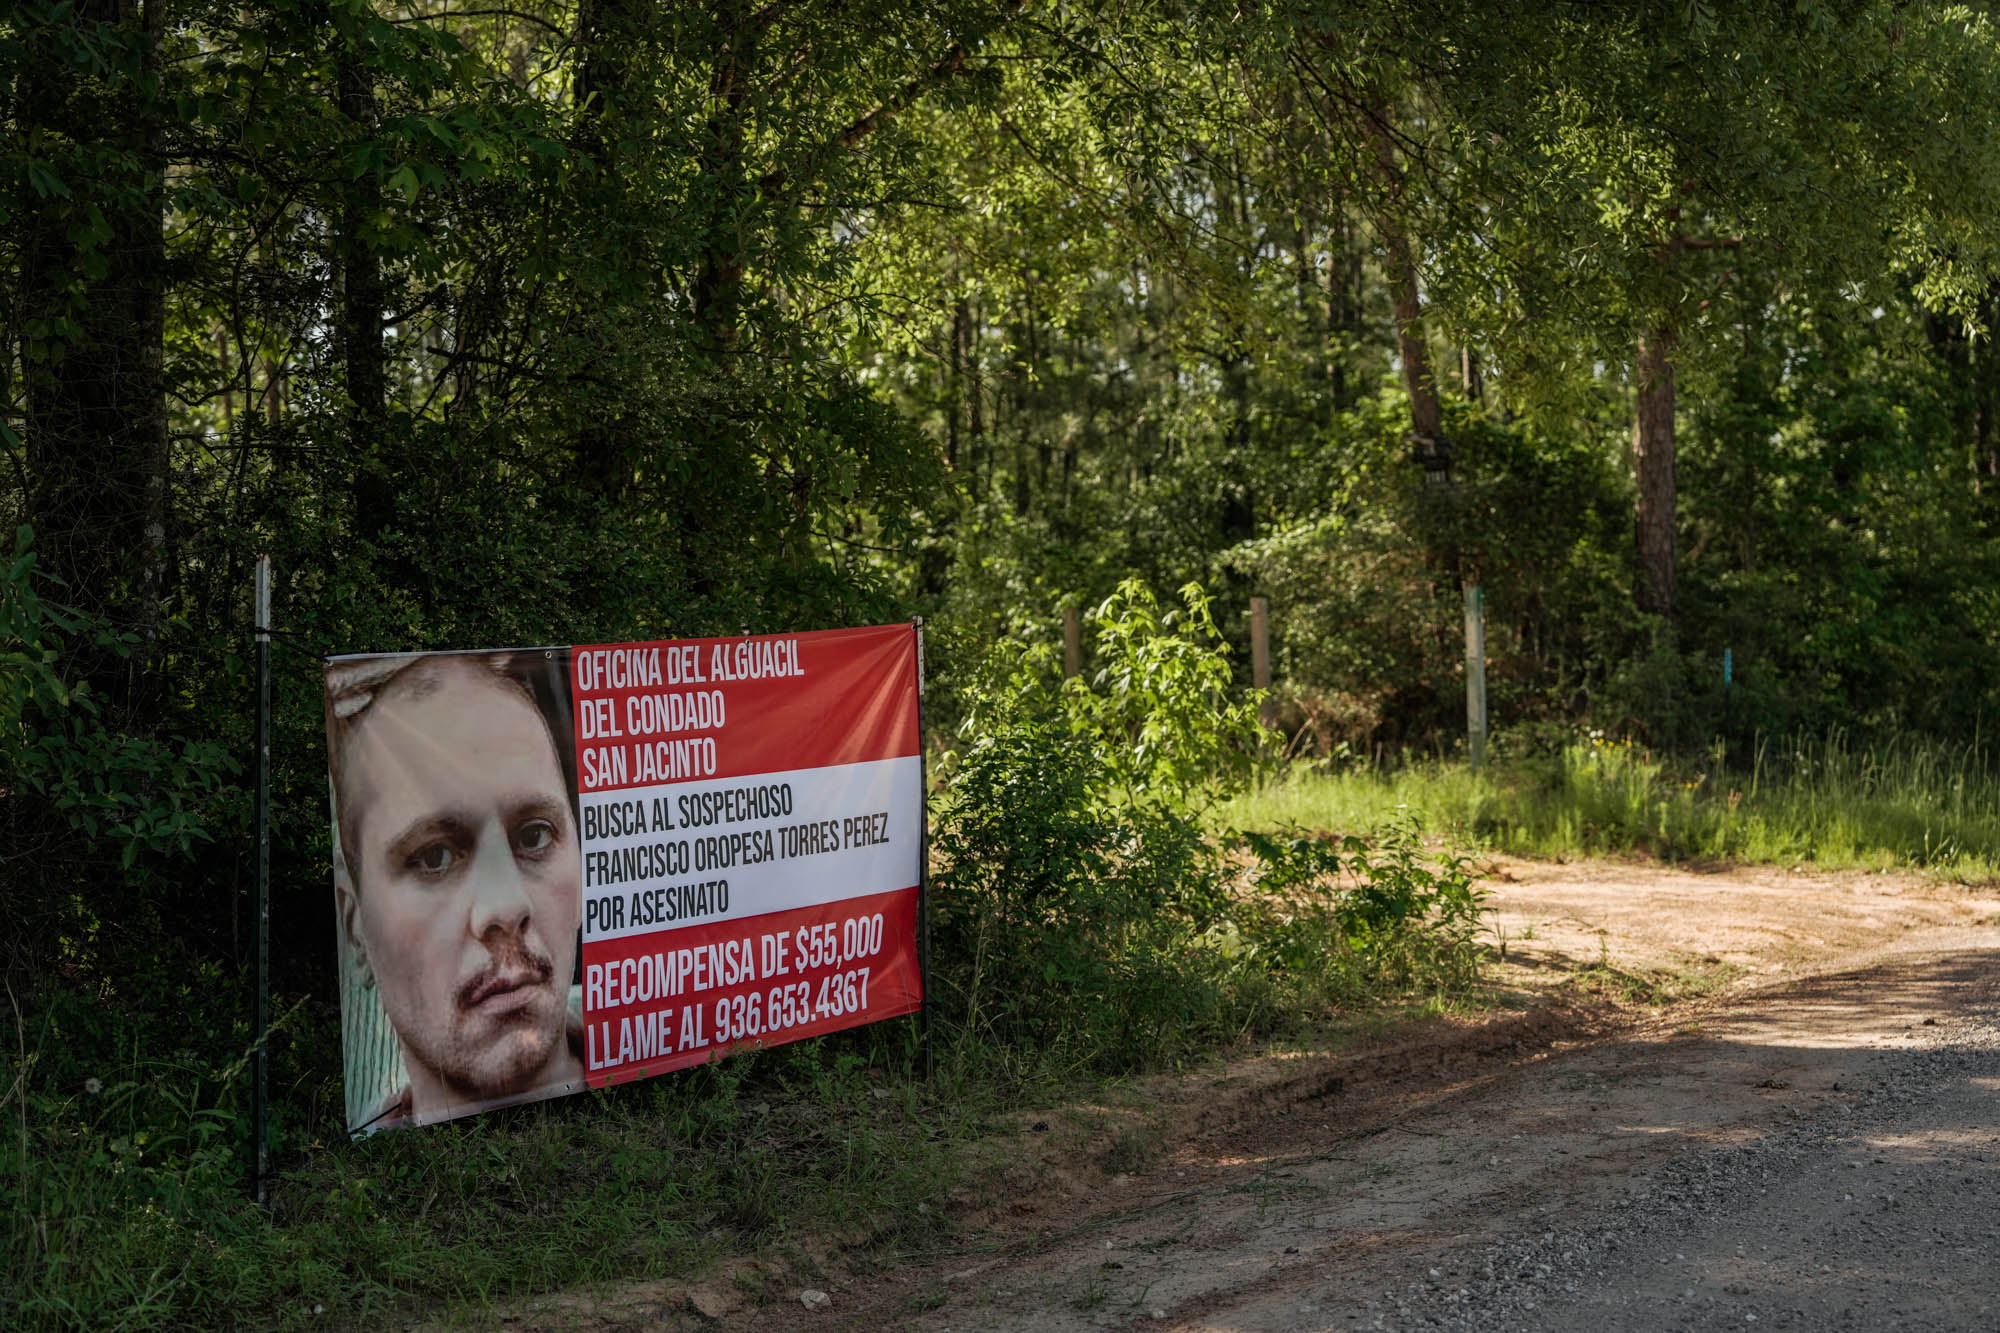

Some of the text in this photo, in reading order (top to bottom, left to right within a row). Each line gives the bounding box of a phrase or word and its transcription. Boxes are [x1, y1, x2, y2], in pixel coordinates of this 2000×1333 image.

[577, 639, 805, 690] OFICINA DEL ALGUACIL
[580, 690, 725, 739] DEL CONDADO
[582, 737, 717, 788] SAN JACINTO
[584, 783, 792, 840] BUSCA AL SOSPECHOSO
[586, 812, 889, 887] FRANCISCO OROPESA TORRES PEREZ
[586, 879, 729, 934] POR ASESINATO
[586, 912, 884, 1011] RECOMPENSA DE $55,000
[587, 967, 870, 1072] LLAME AL 936.653.4367
